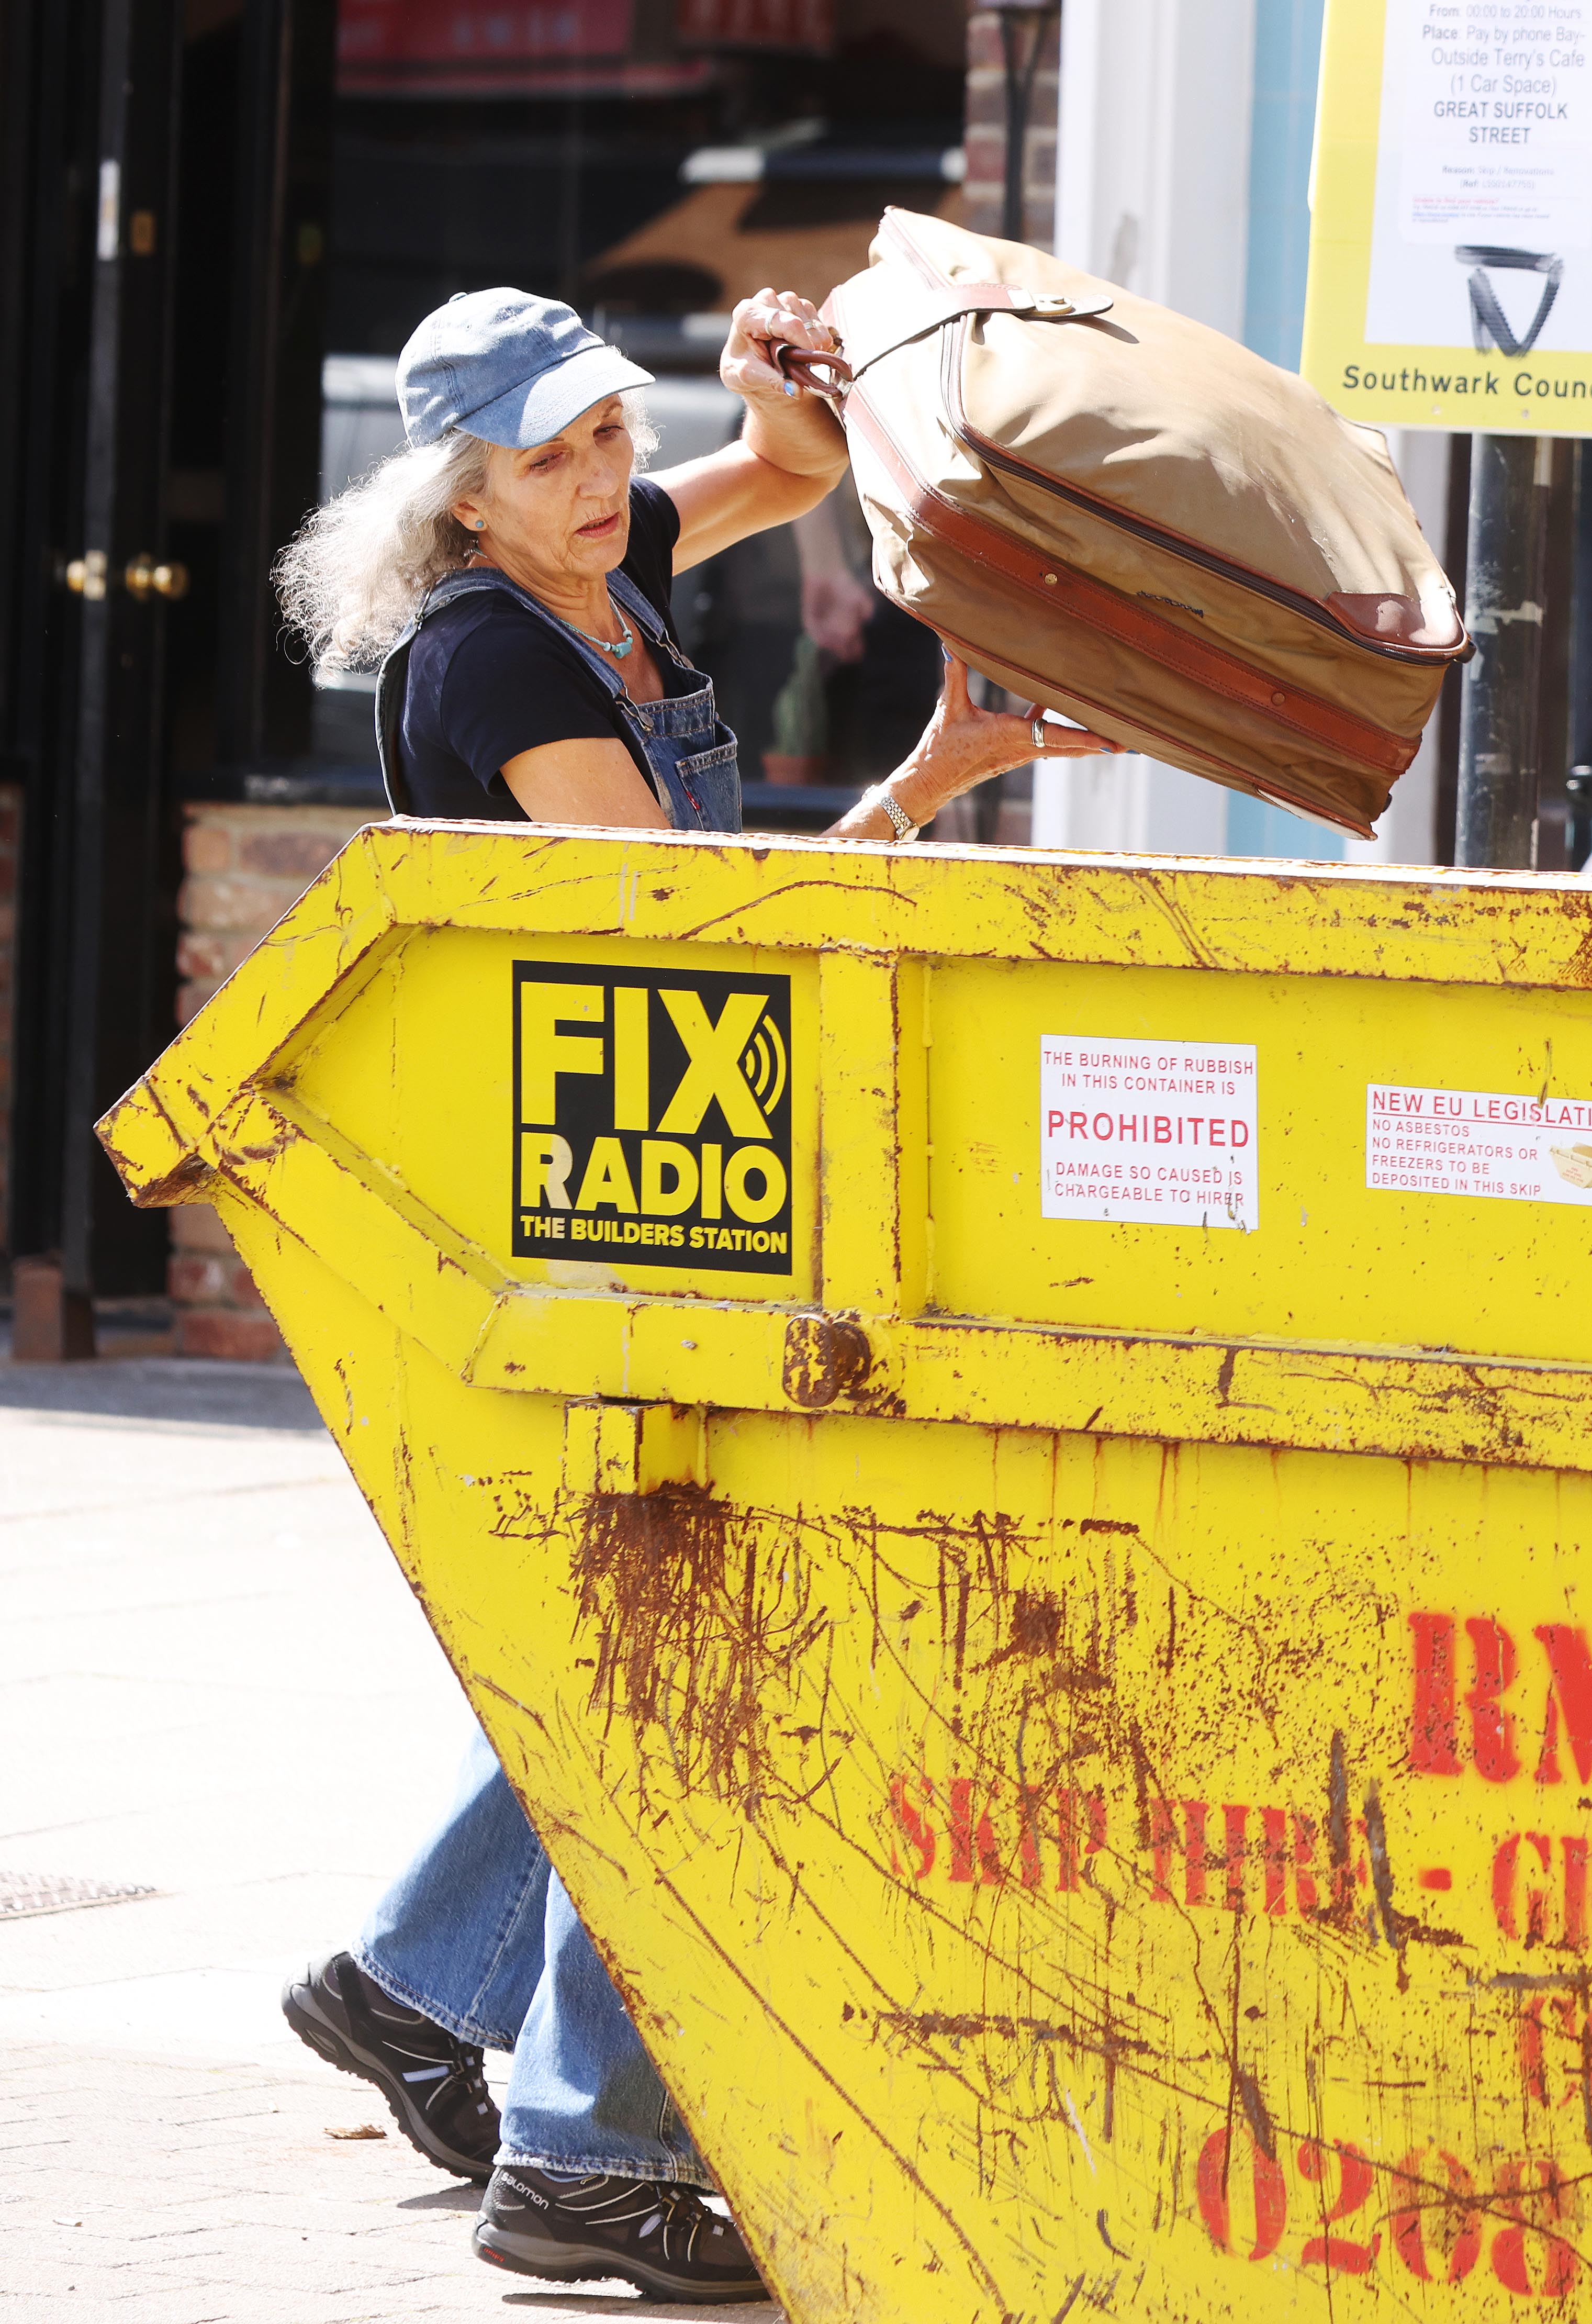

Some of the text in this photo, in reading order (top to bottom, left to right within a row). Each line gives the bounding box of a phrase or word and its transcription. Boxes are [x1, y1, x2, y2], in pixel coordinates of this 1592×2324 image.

[1466, 4, 1497, 18] 00:00
[1500, 5, 1510, 18] to
[1515, 5, 1544, 18] 20:00
[1548, 6, 1582, 19] Hours
[1467, 25, 1489, 43] Pay
[1495, 26, 1508, 43] by
[1513, 26, 1551, 42] phone
[1556, 27, 1585, 44] Bay-
[1432, 47, 1585, 70] Outside Terry's Cafe
[1451, 74, 1557, 97] (1 Car Space)
[1434, 100, 1568, 119] GREAT SUFFOLK
[1470, 127, 1531, 144] STREET
[1343, 364, 1592, 399] Southwark Coun
[521, 981, 773, 1139] FIX
[1044, 1051, 1253, 1075] THE BURNING OF RUBBISH
[1062, 1073, 1235, 1095] IN THIS CONTAINER IS
[1373, 1091, 1423, 1113] NEW
[1433, 1096, 1462, 1116] EU
[1048, 1110, 1249, 1148] PROHIBITED
[1372, 1119, 1470, 1137] NO ASBESTOS
[1372, 1137, 1538, 1160] NO REFRIGERATORS OR
[1056, 1161, 1242, 1185] DAMAGE SO CAUSED IS
[1372, 1154, 1490, 1175] FREEZERS TO BE
[520, 1132, 787, 1223] RADIO
[1372, 1172, 1541, 1197] DEPOSITED IN THIS SKIP
[1055, 1183, 1163, 1202] CHARGEABLE
[1170, 1189, 1190, 1202] TO
[520, 1215, 787, 1254] THE BUILDERS STATION
[888, 1773, 1107, 1893] SKIP
